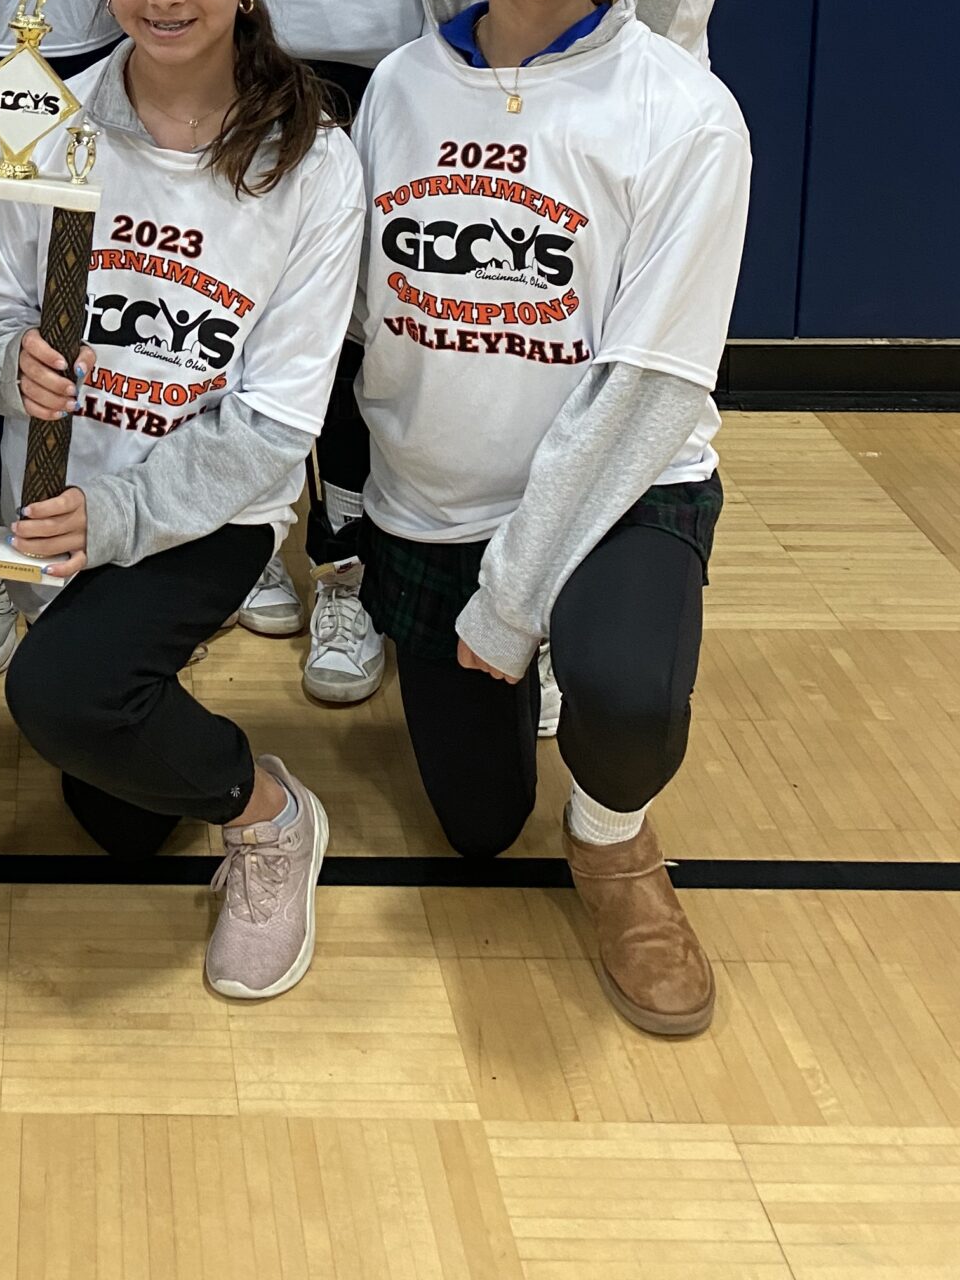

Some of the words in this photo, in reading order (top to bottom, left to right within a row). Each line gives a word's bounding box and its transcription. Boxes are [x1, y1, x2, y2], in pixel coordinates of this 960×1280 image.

[437, 141, 527, 173] 2023
[374, 174, 589, 233] TOURNAMENT
[111, 215, 203, 258] 2023
[382, 218, 574, 286] GCCYS
[89, 249, 255, 319] URNAMENT
[387, 272, 579, 325] CHAMPIONS
[530, 278, 548, 290] Ohio
[84, 298, 240, 369] CCYS
[384, 317, 590, 364] VOLLEYBALL
[185, 358, 207, 372] Ohio
